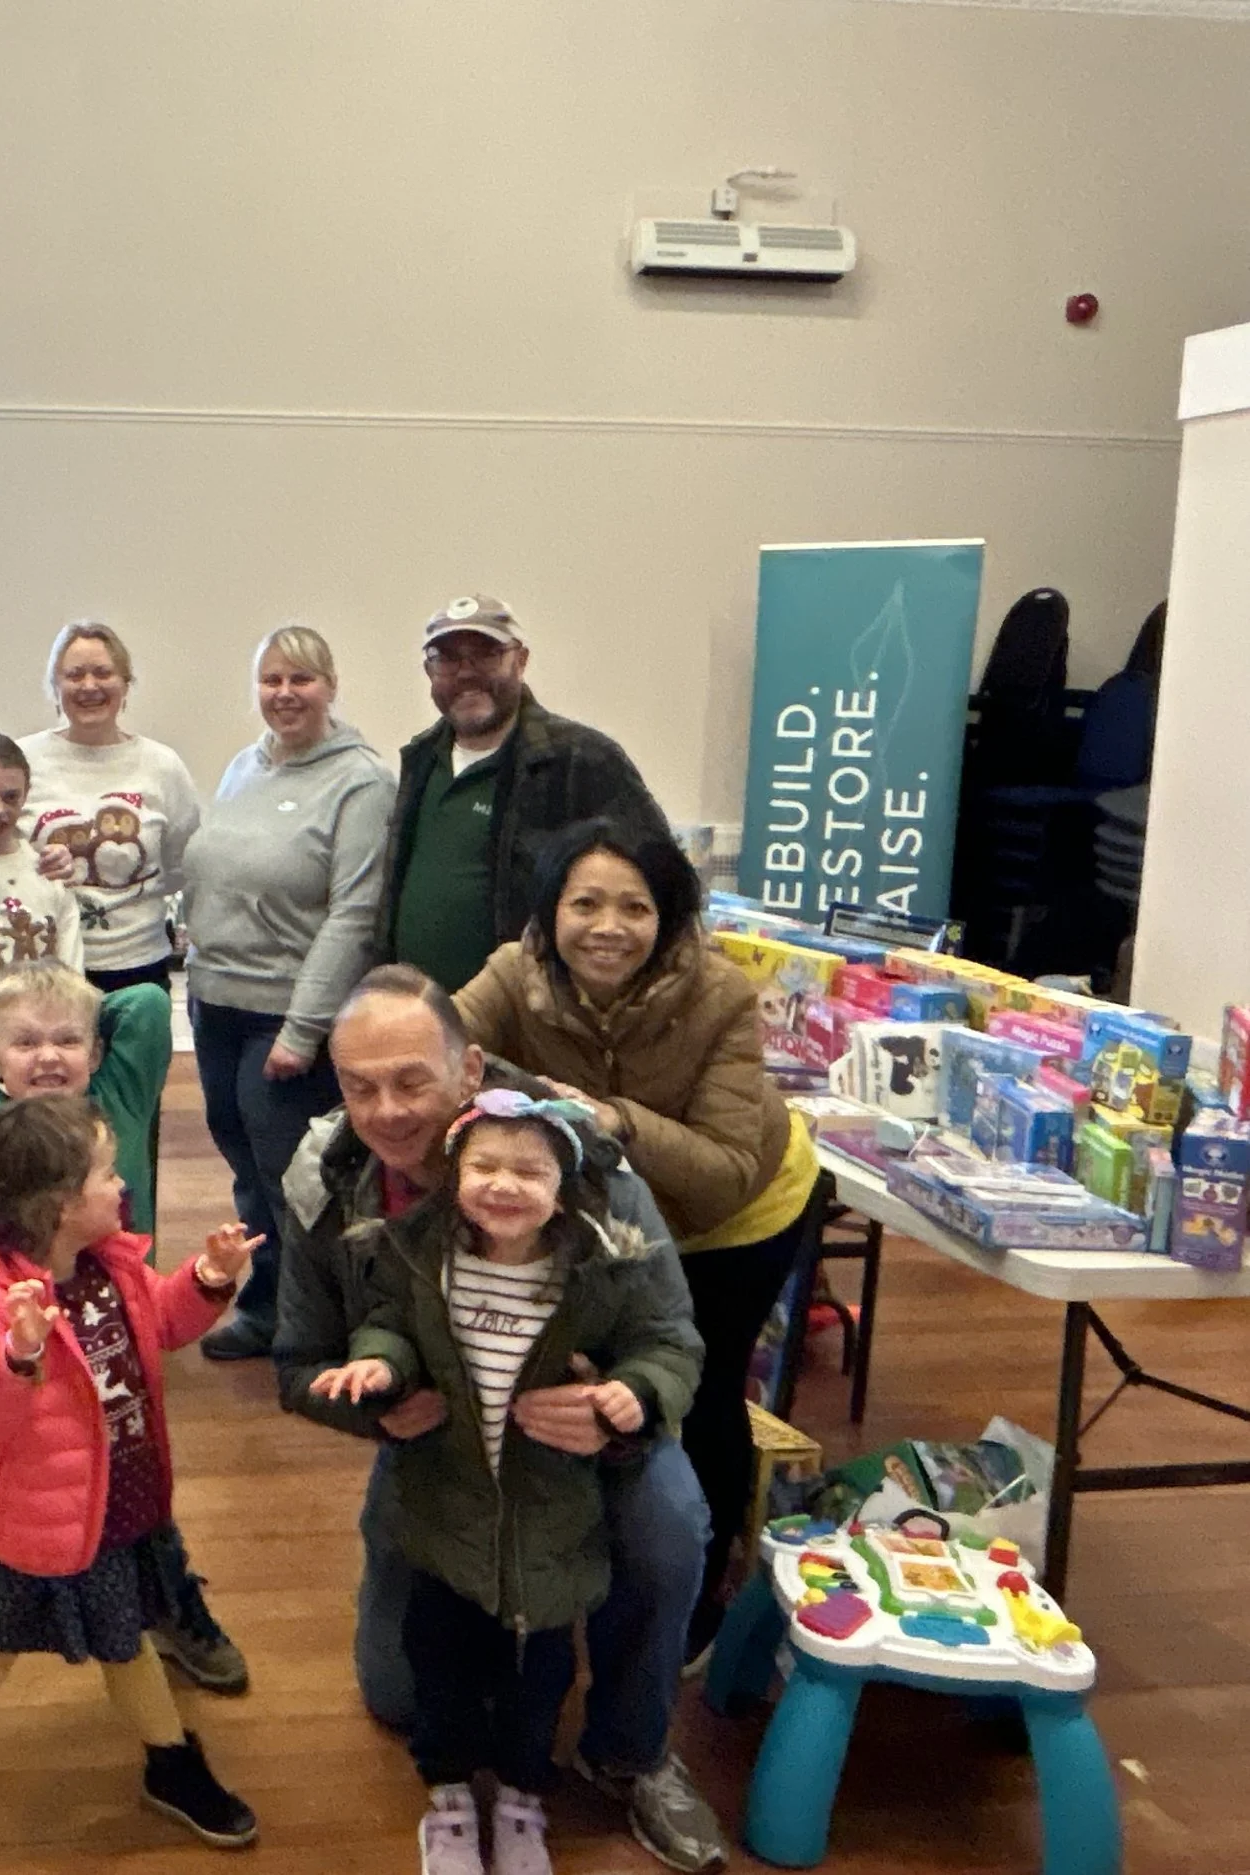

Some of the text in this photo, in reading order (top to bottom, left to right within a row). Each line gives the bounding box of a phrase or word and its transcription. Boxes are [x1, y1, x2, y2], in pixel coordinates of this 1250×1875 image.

[763, 686, 820, 910] EBUILD.
[819, 670, 880, 912] ESTORE.
[876, 771, 929, 916] AISE.
